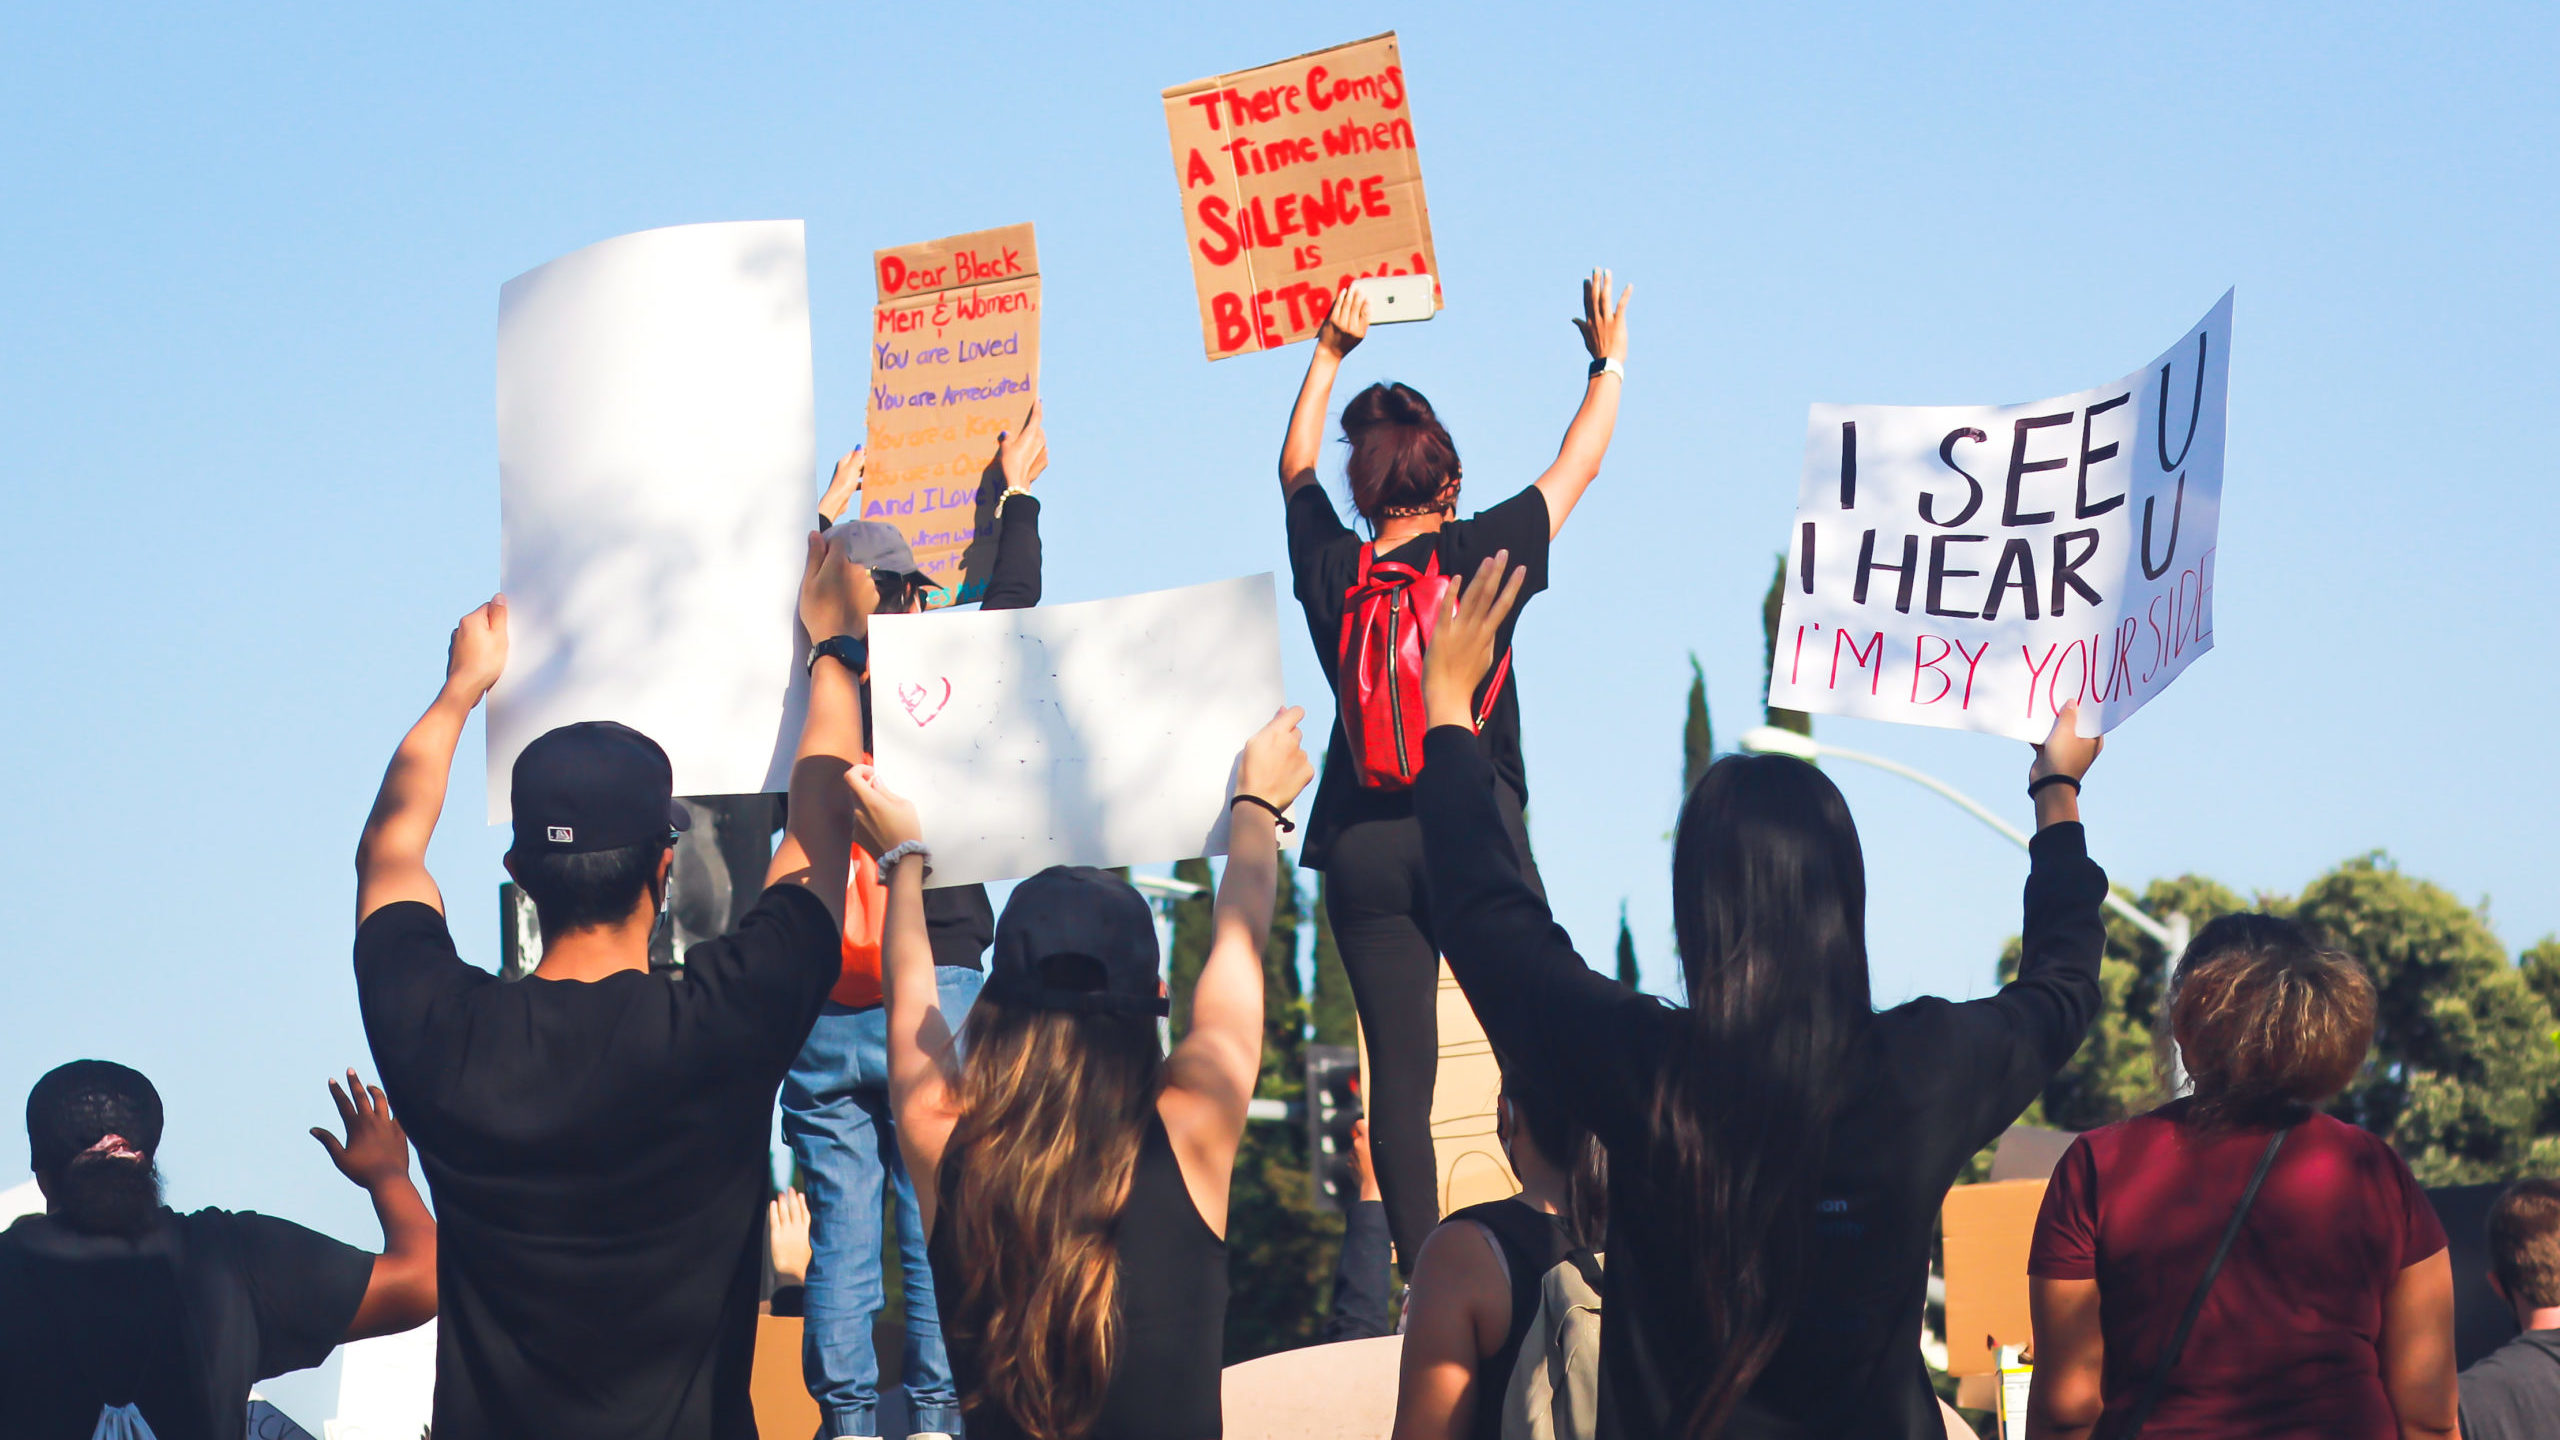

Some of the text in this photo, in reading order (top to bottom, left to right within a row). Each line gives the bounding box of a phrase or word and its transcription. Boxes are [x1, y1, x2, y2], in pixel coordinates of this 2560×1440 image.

[1189, 65, 1404, 131] There Comes
[1187, 148, 1215, 189] A
[1221, 137, 1319, 177] Time
[1197, 175, 1391, 267] SILENCE
[879, 246, 1023, 295] Dear Black
[1293, 245, 1323, 271] IS
[877, 308, 925, 333] Men
[875, 331, 1019, 370] You are Loved
[873, 384, 906, 411] You
[908, 390, 936, 407] are
[870, 423, 904, 450] You
[907, 427, 938, 446] are
[1839, 331, 2207, 528] I SEE U
[867, 461, 898, 487] You
[864, 491, 915, 518] And
[919, 487, 938, 513] I
[1800, 470, 2186, 621] I HEAR U
[1791, 546, 2217, 719] I'M BY YOUR SIDE
